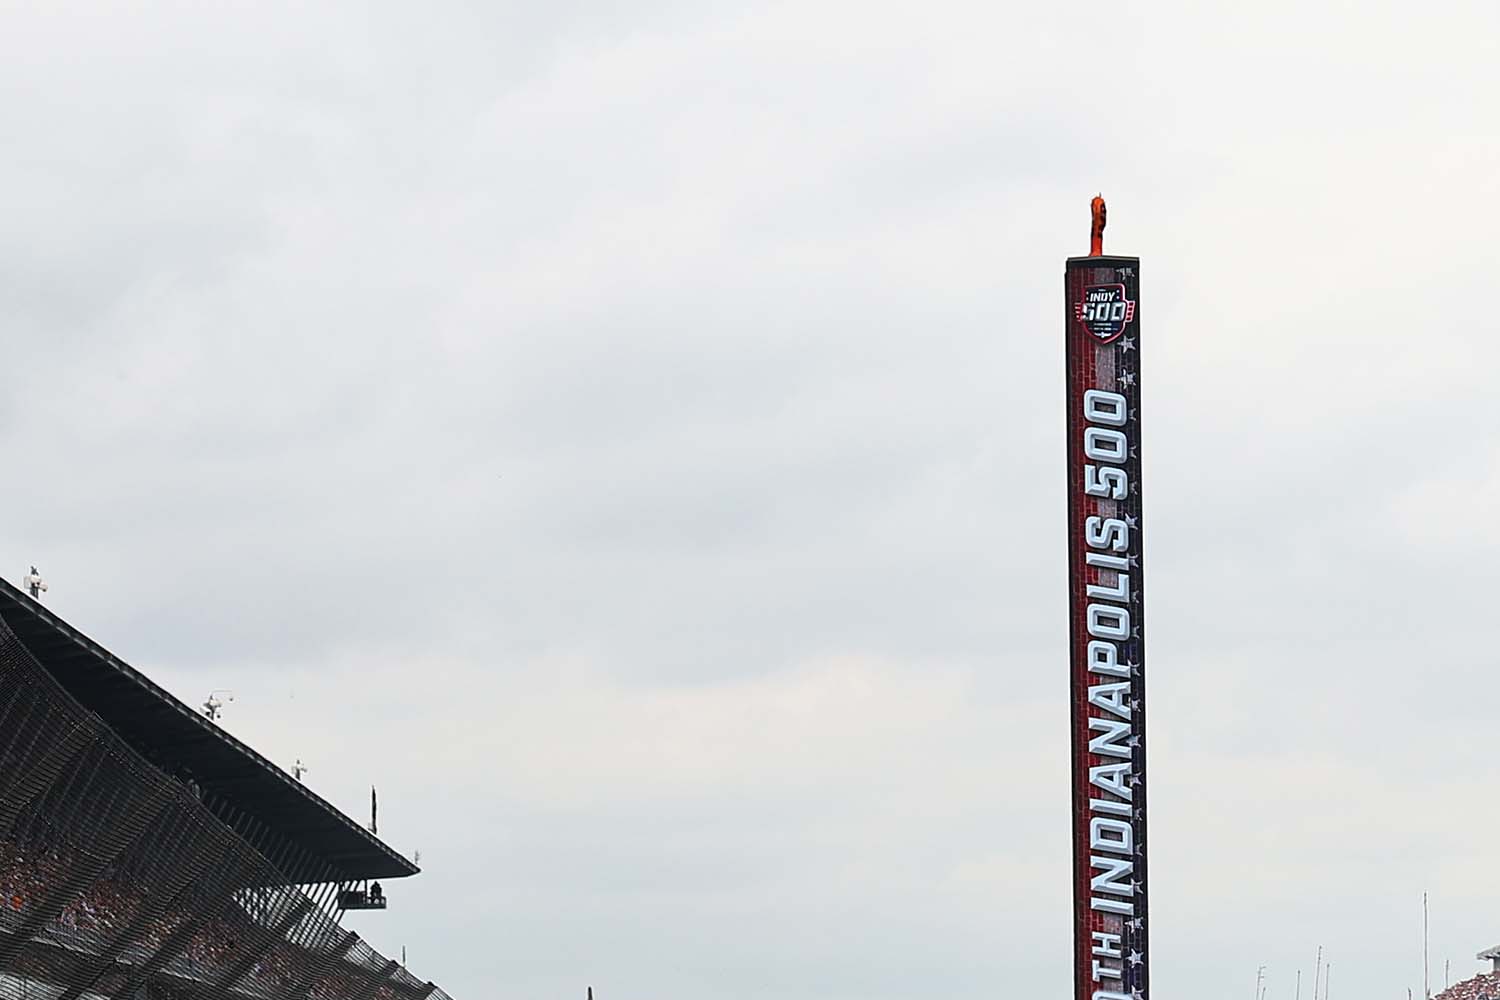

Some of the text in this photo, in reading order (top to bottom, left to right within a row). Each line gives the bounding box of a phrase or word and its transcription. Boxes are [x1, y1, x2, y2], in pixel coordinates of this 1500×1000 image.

[1082, 302, 1126, 321] 500
[1090, 292, 1115, 302] INDY
[1083, 389, 1128, 500] 500
[1085, 516, 1135, 915] INDIANAPOLIS
